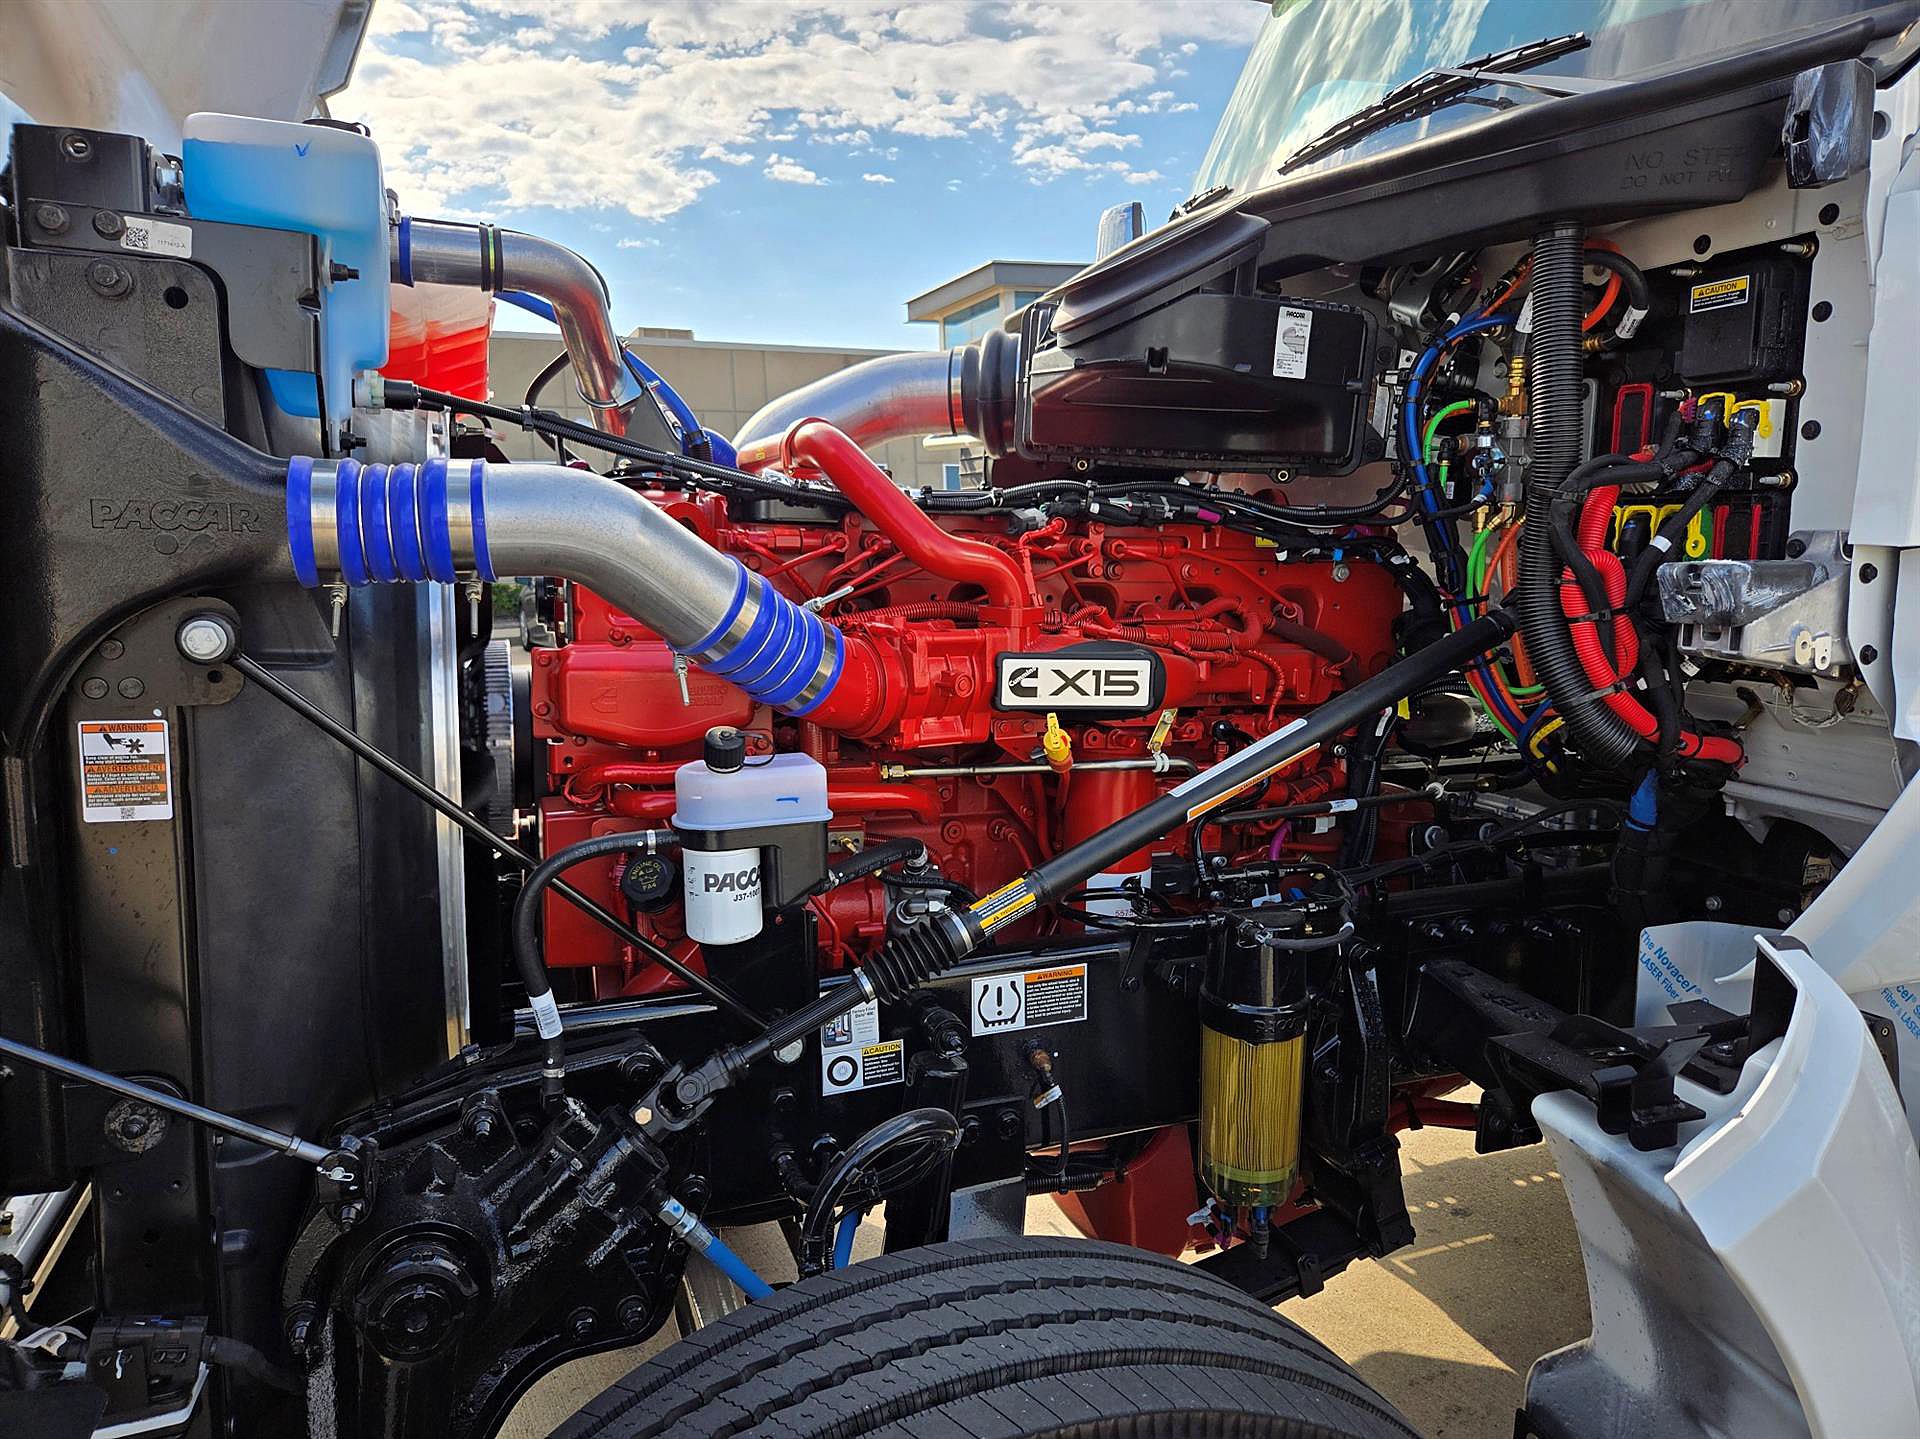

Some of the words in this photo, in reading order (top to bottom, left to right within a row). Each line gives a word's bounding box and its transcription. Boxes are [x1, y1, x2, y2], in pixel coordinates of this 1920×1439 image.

[1704, 282, 1738, 296] CAUTION
[89, 499, 261, 533] PACCAR
[1049, 669, 1141, 697] X15
[108, 723, 149, 732] WARNING
[95, 763, 162, 772] AVERTISSEMENT
[103, 784, 159, 793] ADVERTENCIA
[1640, 930, 1655, 951] The
[1042, 970, 1073, 979] WARNING
[1640, 953, 1663, 982] LASER
[1661, 977, 1680, 1000] Fiber
[1880, 988, 1899, 1009] Fiber
[869, 1043, 901, 1055] CAUTION
